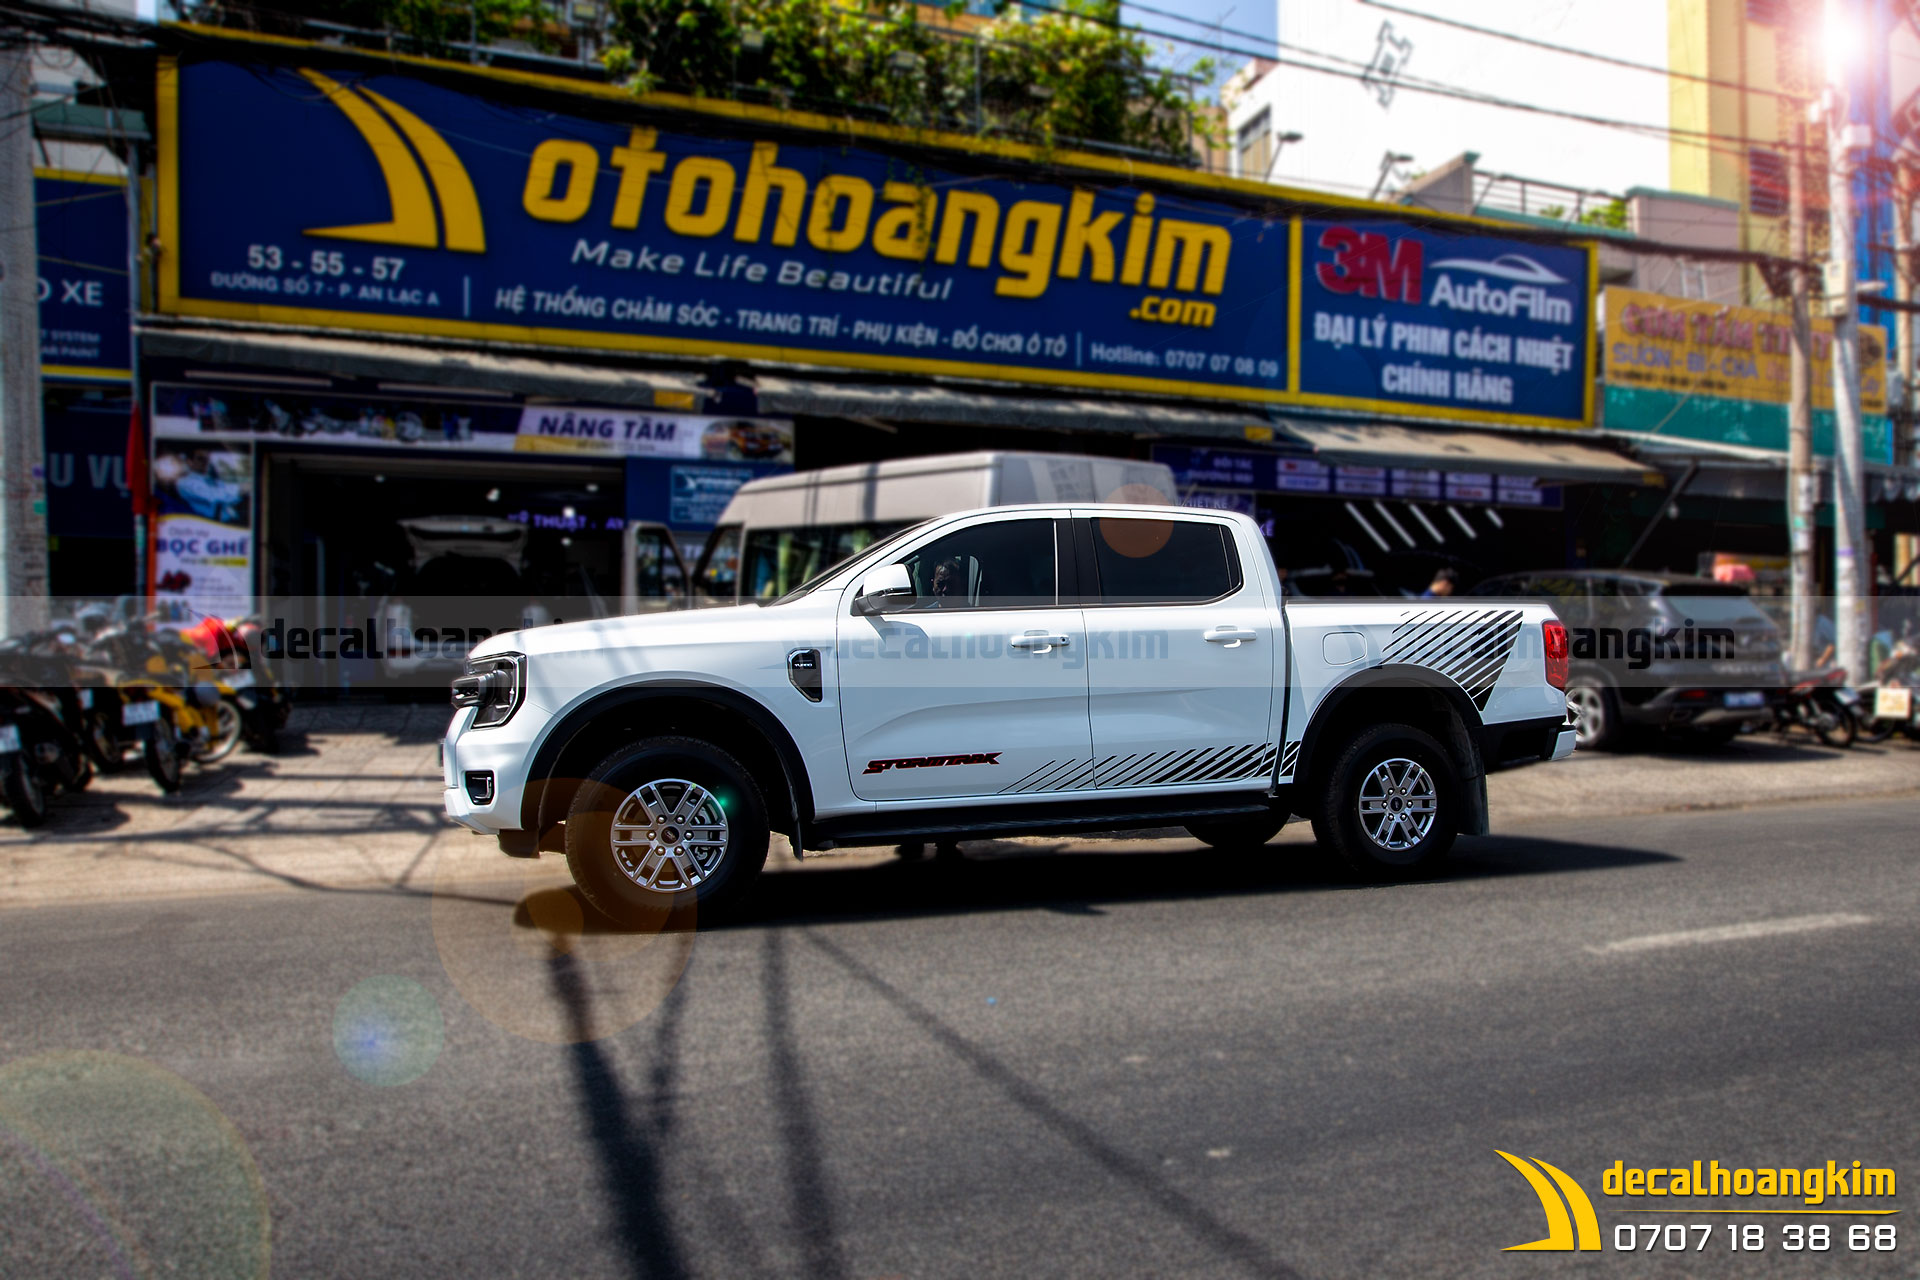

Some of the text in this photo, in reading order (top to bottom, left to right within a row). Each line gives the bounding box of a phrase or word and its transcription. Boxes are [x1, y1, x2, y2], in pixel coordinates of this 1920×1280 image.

[522, 125, 1231, 298] otohoangkim
[248, 245, 282, 270] 53
[311, 251, 344, 275] 55
[372, 256, 404, 281] 57
[571, 239, 953, 301] Make Life Beautiful
[1316, 226, 1424, 305] 3M
[61, 277, 104, 308] XE
[315, 281, 324, 295] 7
[358, 285, 383, 301] AN
[426, 291, 440, 306] A
[1129, 295, 1217, 327] .com
[1429, 274, 1573, 325] AutoFilm
[495, 288, 525, 315] HỆ
[532, 285, 607, 319] THỐNG
[677, 298, 720, 327] SÓC
[736, 308, 802, 336] TRANG
[808, 311, 841, 338] TRÍ
[852, 320, 890, 346] PHỤ
[1314, 311, 1354, 350] ĐẠI
[1360, 308, 1387, 348] LÝ
[1392, 322, 1450, 357] PHIM
[1455, 326, 1512, 365] CÁCH
[1165, 349, 1206, 370] 0707
[1382, 360, 1450, 398] CHÍNH
[538, 412, 614, 438] NÂNG
[862, 752, 1003, 774] STORMTRAK
